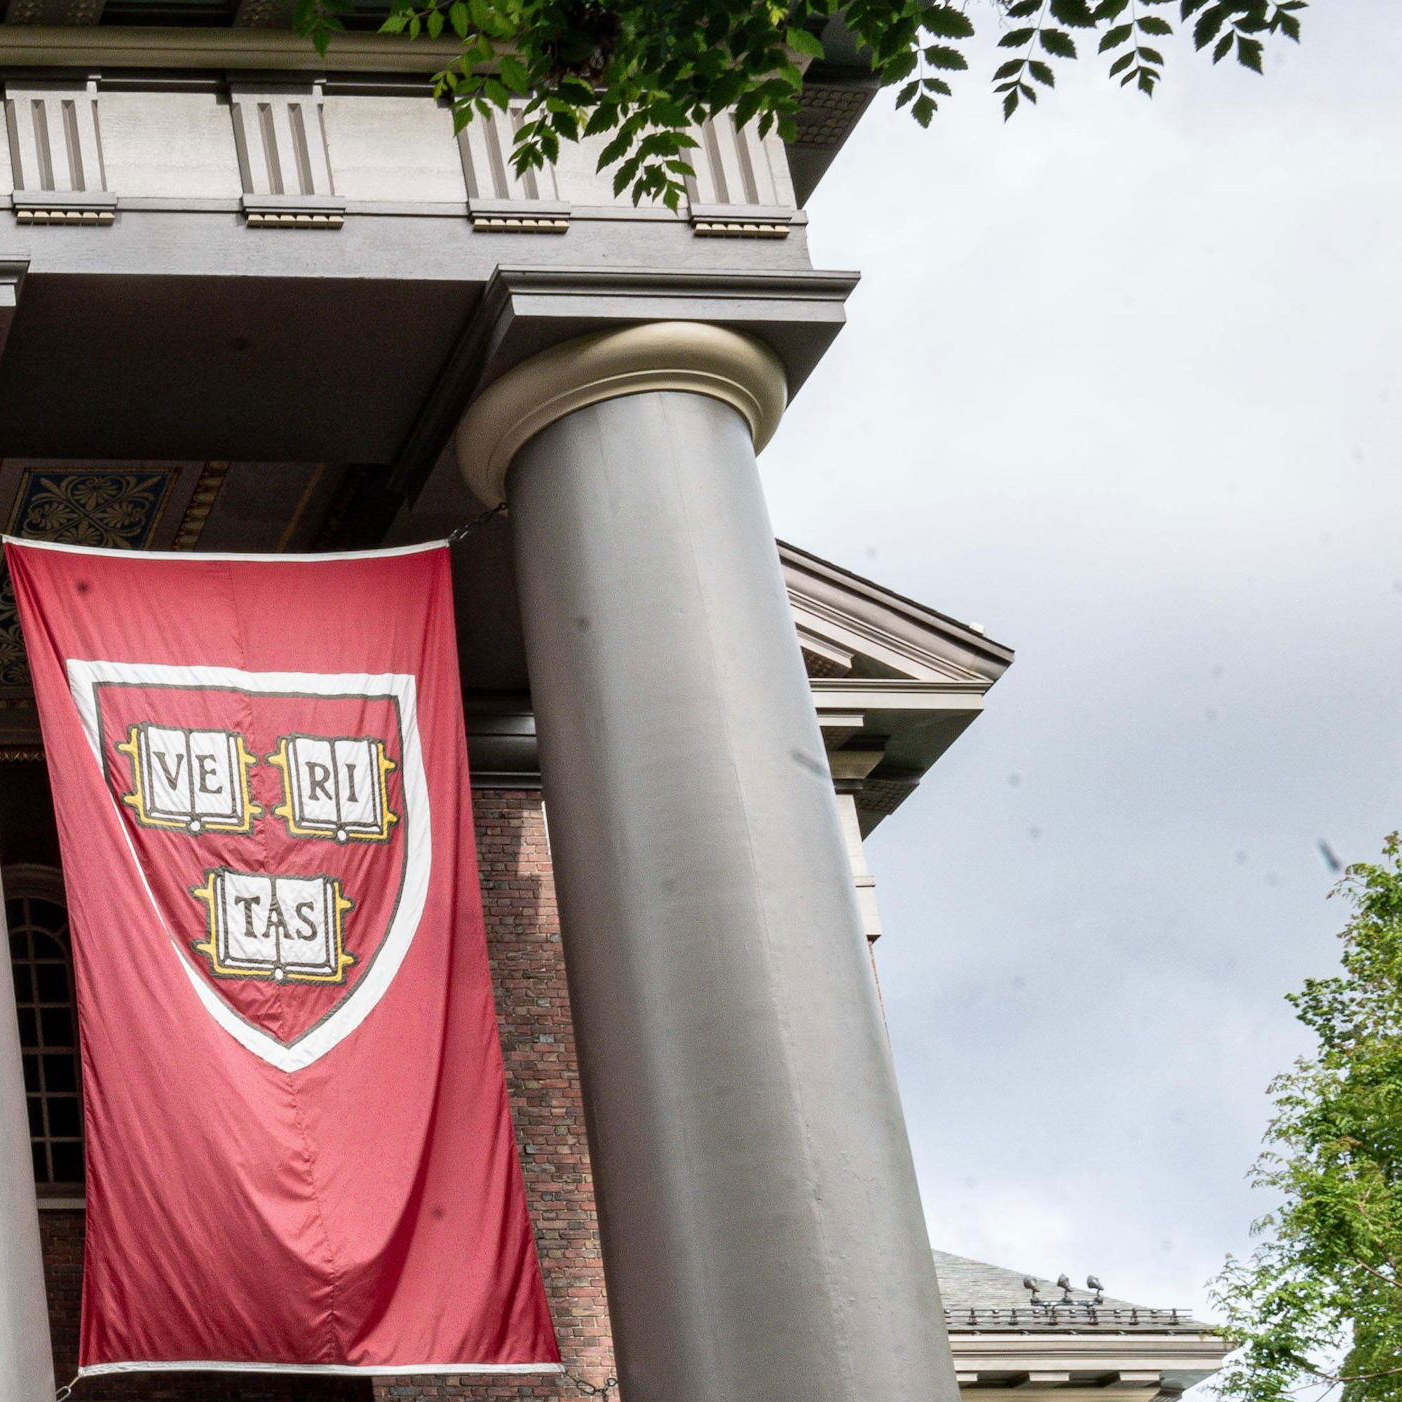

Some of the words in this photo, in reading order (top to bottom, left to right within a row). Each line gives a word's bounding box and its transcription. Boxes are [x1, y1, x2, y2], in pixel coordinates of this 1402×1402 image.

[153, 751, 223, 794] VE
[306, 761, 360, 802] RI
[234, 895, 318, 942] TAS
